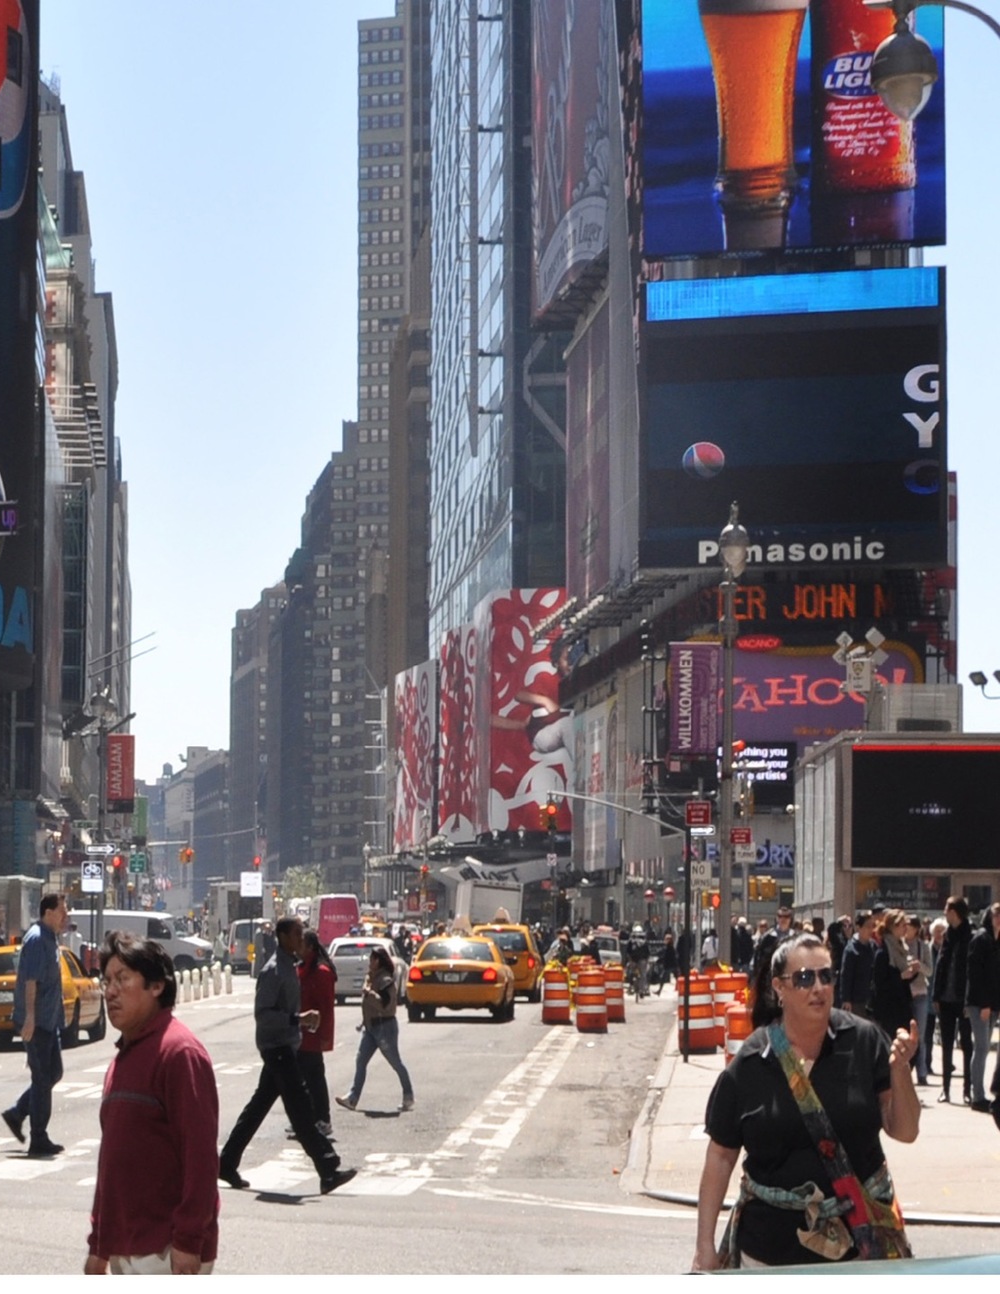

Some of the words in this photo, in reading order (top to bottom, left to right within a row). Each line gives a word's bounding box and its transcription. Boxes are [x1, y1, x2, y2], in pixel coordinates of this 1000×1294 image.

[834, 56, 873, 73] BU
[824, 73, 871, 89] LIG
[698, 536, 886, 564] Pnasonic
[783, 584, 857, 620] JOHN
[677, 650, 694, 750] WILLKOMMEN
